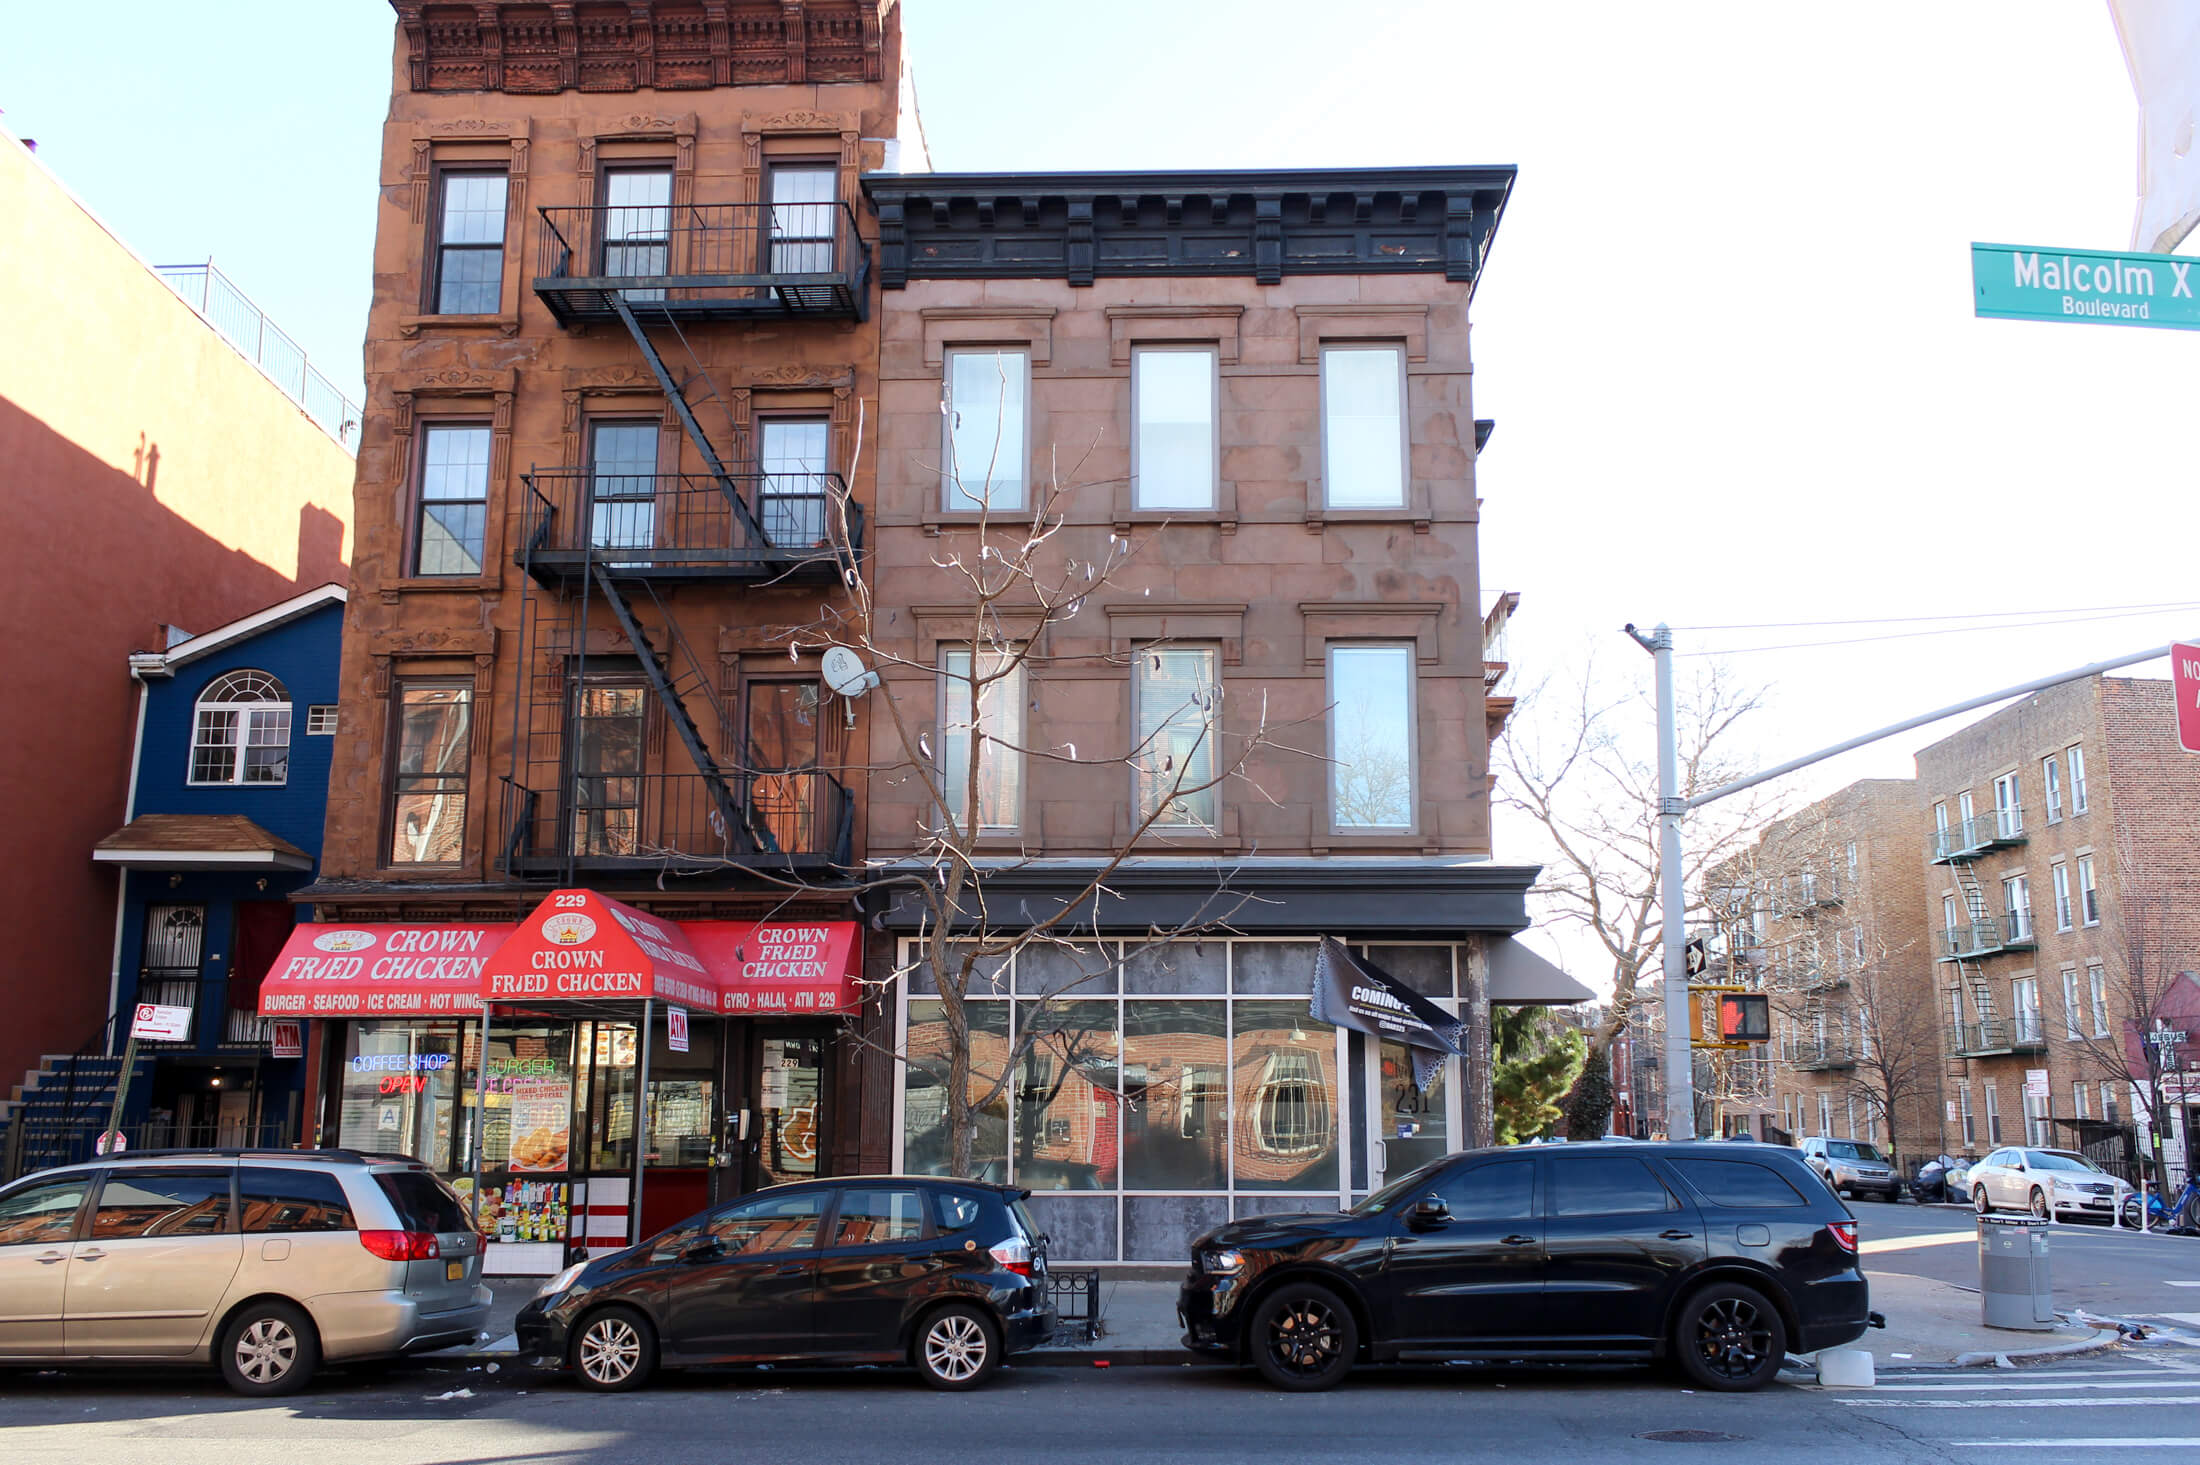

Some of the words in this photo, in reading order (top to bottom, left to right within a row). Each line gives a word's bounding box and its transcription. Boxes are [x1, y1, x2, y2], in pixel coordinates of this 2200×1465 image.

[2013, 252, 2154, 296] Malcolm
[2170, 262, 2193, 298] X
[2062, 296, 2150, 319] Boulevard
[555, 895, 586, 907] 229
[385, 930, 485, 952] CROWN
[758, 928, 829, 944] CROWN
[531, 950, 605, 969] CROWN
[759, 945, 817, 961] FRIED
[281, 957, 364, 980] FRIED
[370, 957, 489, 980] CHICKEN
[742, 962, 827, 978] CHICKEN
[491, 975, 549, 993] FRIED
[557, 973, 643, 992] CHICKEN
[264, 994, 306, 1010] BURGER
[313, 994, 360, 1010] SEAFOOD
[367, 994, 385, 1009] ICE
[386, 994, 421, 1009] CREAM
[429, 994, 451, 1008] HOT
[723, 992, 750, 1009] GYRO
[757, 992, 787, 1008] HALAL
[794, 992, 814, 1008] ATM
[818, 992, 836, 1008] 229
[670, 1013, 688, 1040] ATM
[275, 1025, 299, 1048] ATM
[352, 1055, 404, 1073] COFFEE
[408, 1053, 450, 1071] SHOP
[781, 1060, 798, 1068] 229
[378, 1075, 428, 1094] OPEN
[516, 1086, 538, 1095] MIXED
[540, 1084, 569, 1093] CHICKEN
[1396, 1083, 1430, 1113] 231
[382, 1108, 395, 1124] A
